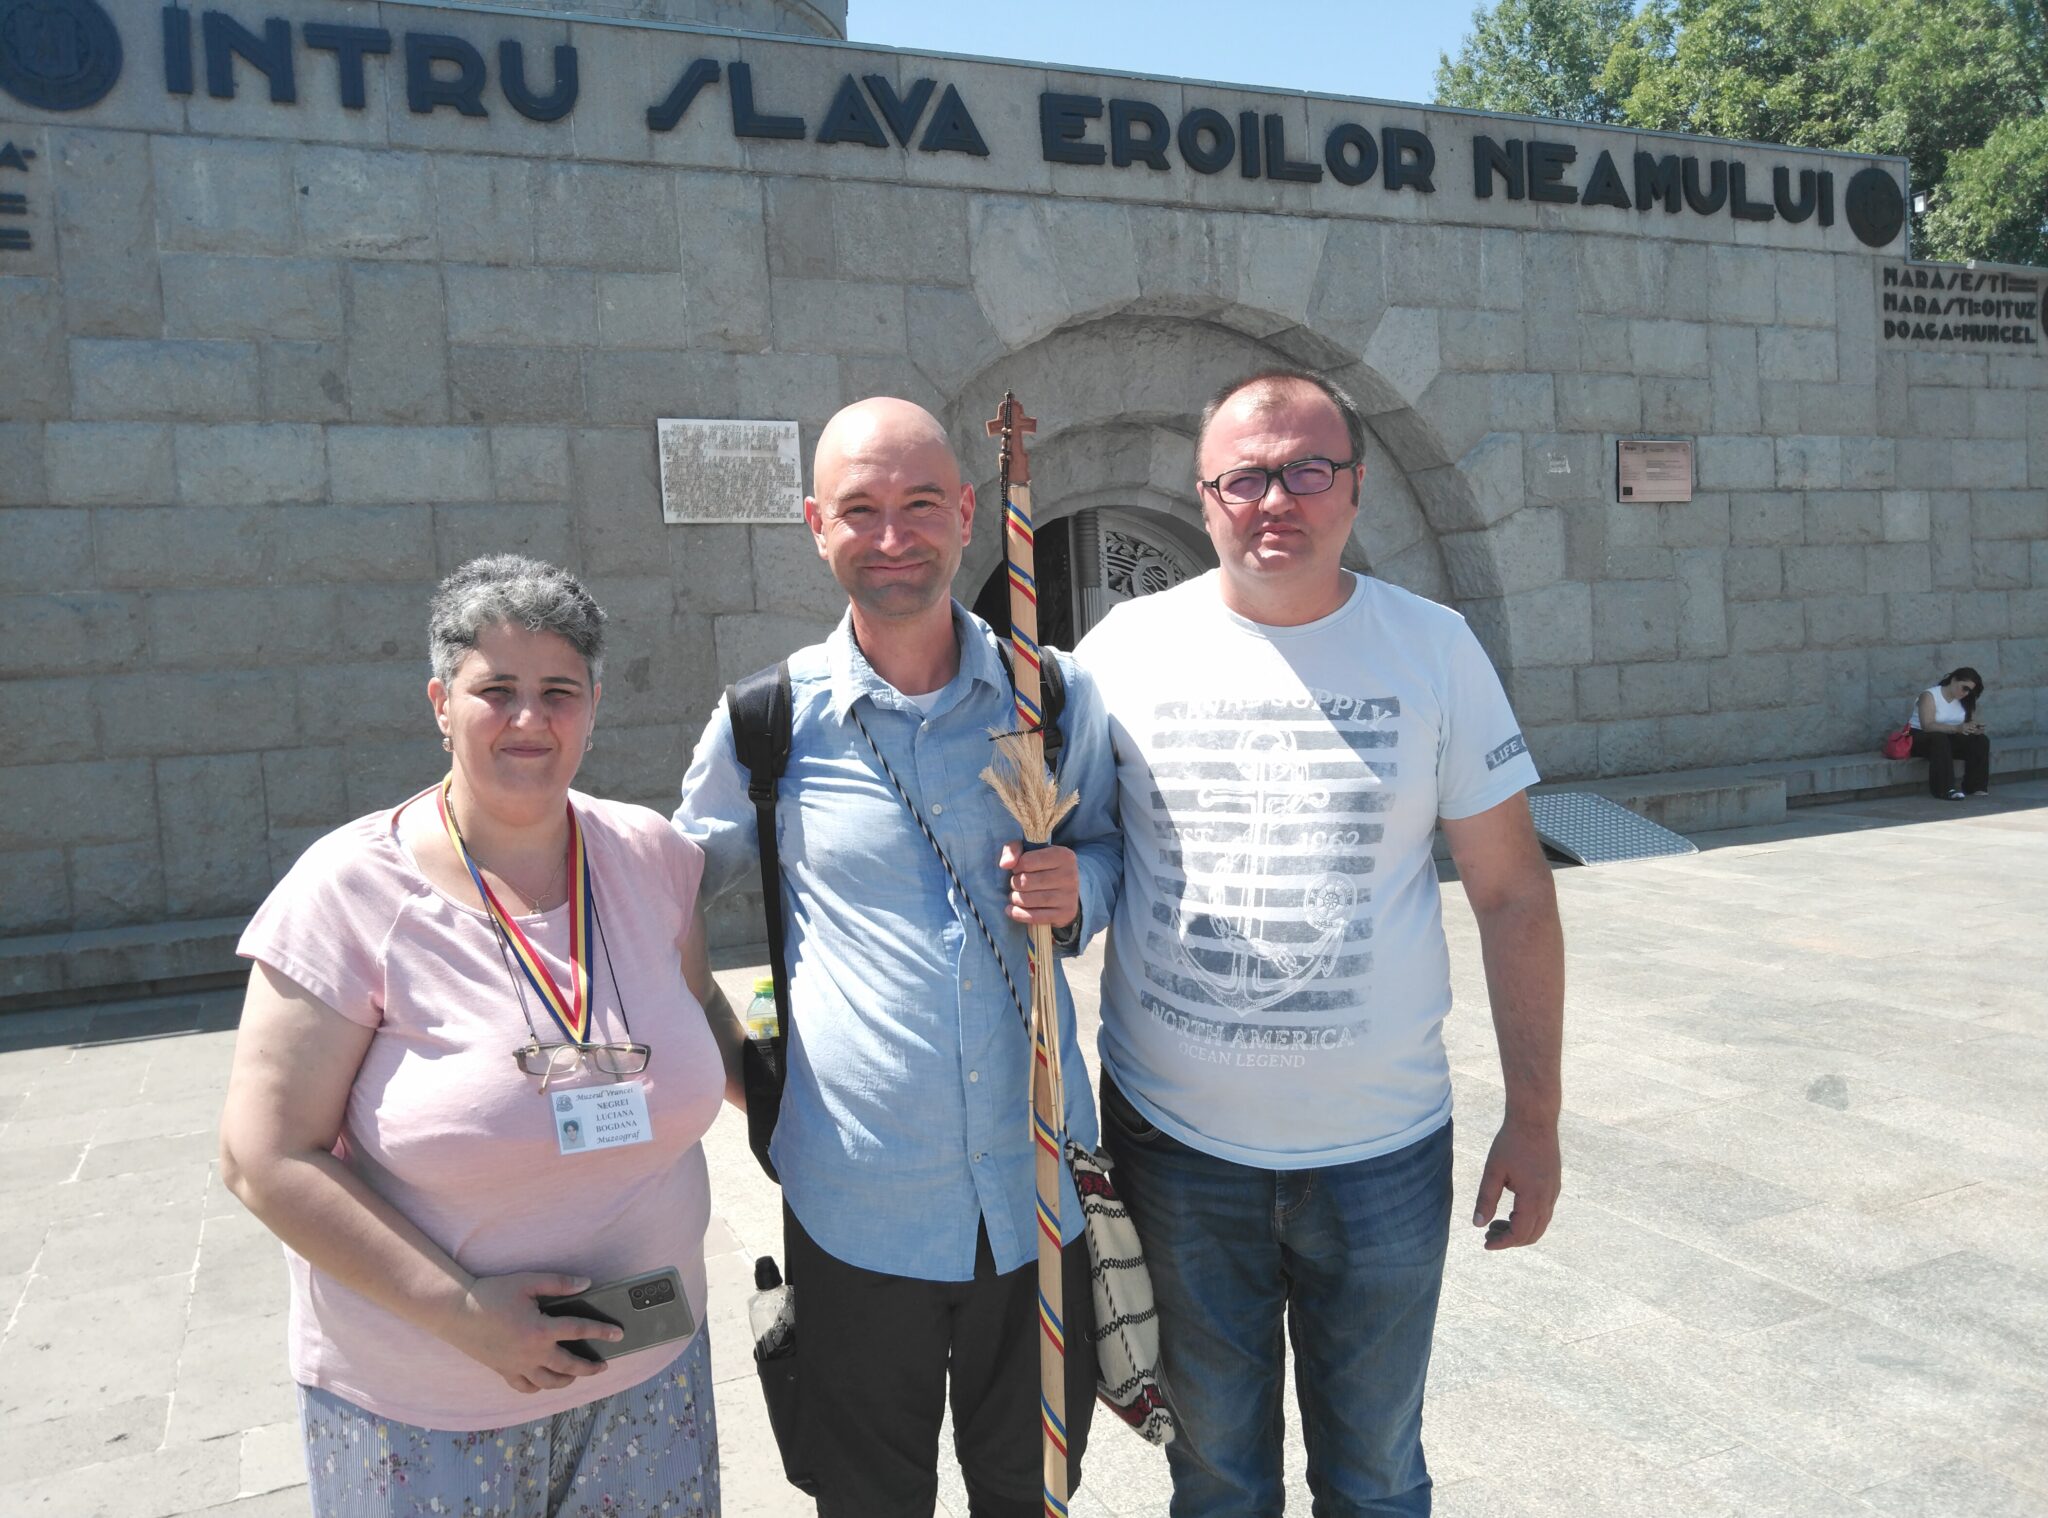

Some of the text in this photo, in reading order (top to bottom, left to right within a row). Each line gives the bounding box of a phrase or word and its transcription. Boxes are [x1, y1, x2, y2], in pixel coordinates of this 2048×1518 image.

[162, 4, 1834, 227] INTRU SLAVA EROILOR NEAMULUI
[1491, 740, 1520, 764] LIFE
[1299, 830, 1360, 852] 1962
[1150, 1002, 1354, 1051] NORTH AMERICA
[1179, 1041, 1306, 1068] OCEAN LEGEND
[596, 1109, 634, 1121] LUCIANA
[597, 1098, 629, 1110] NEGREI
[596, 1120, 637, 1133] BOGDANA
